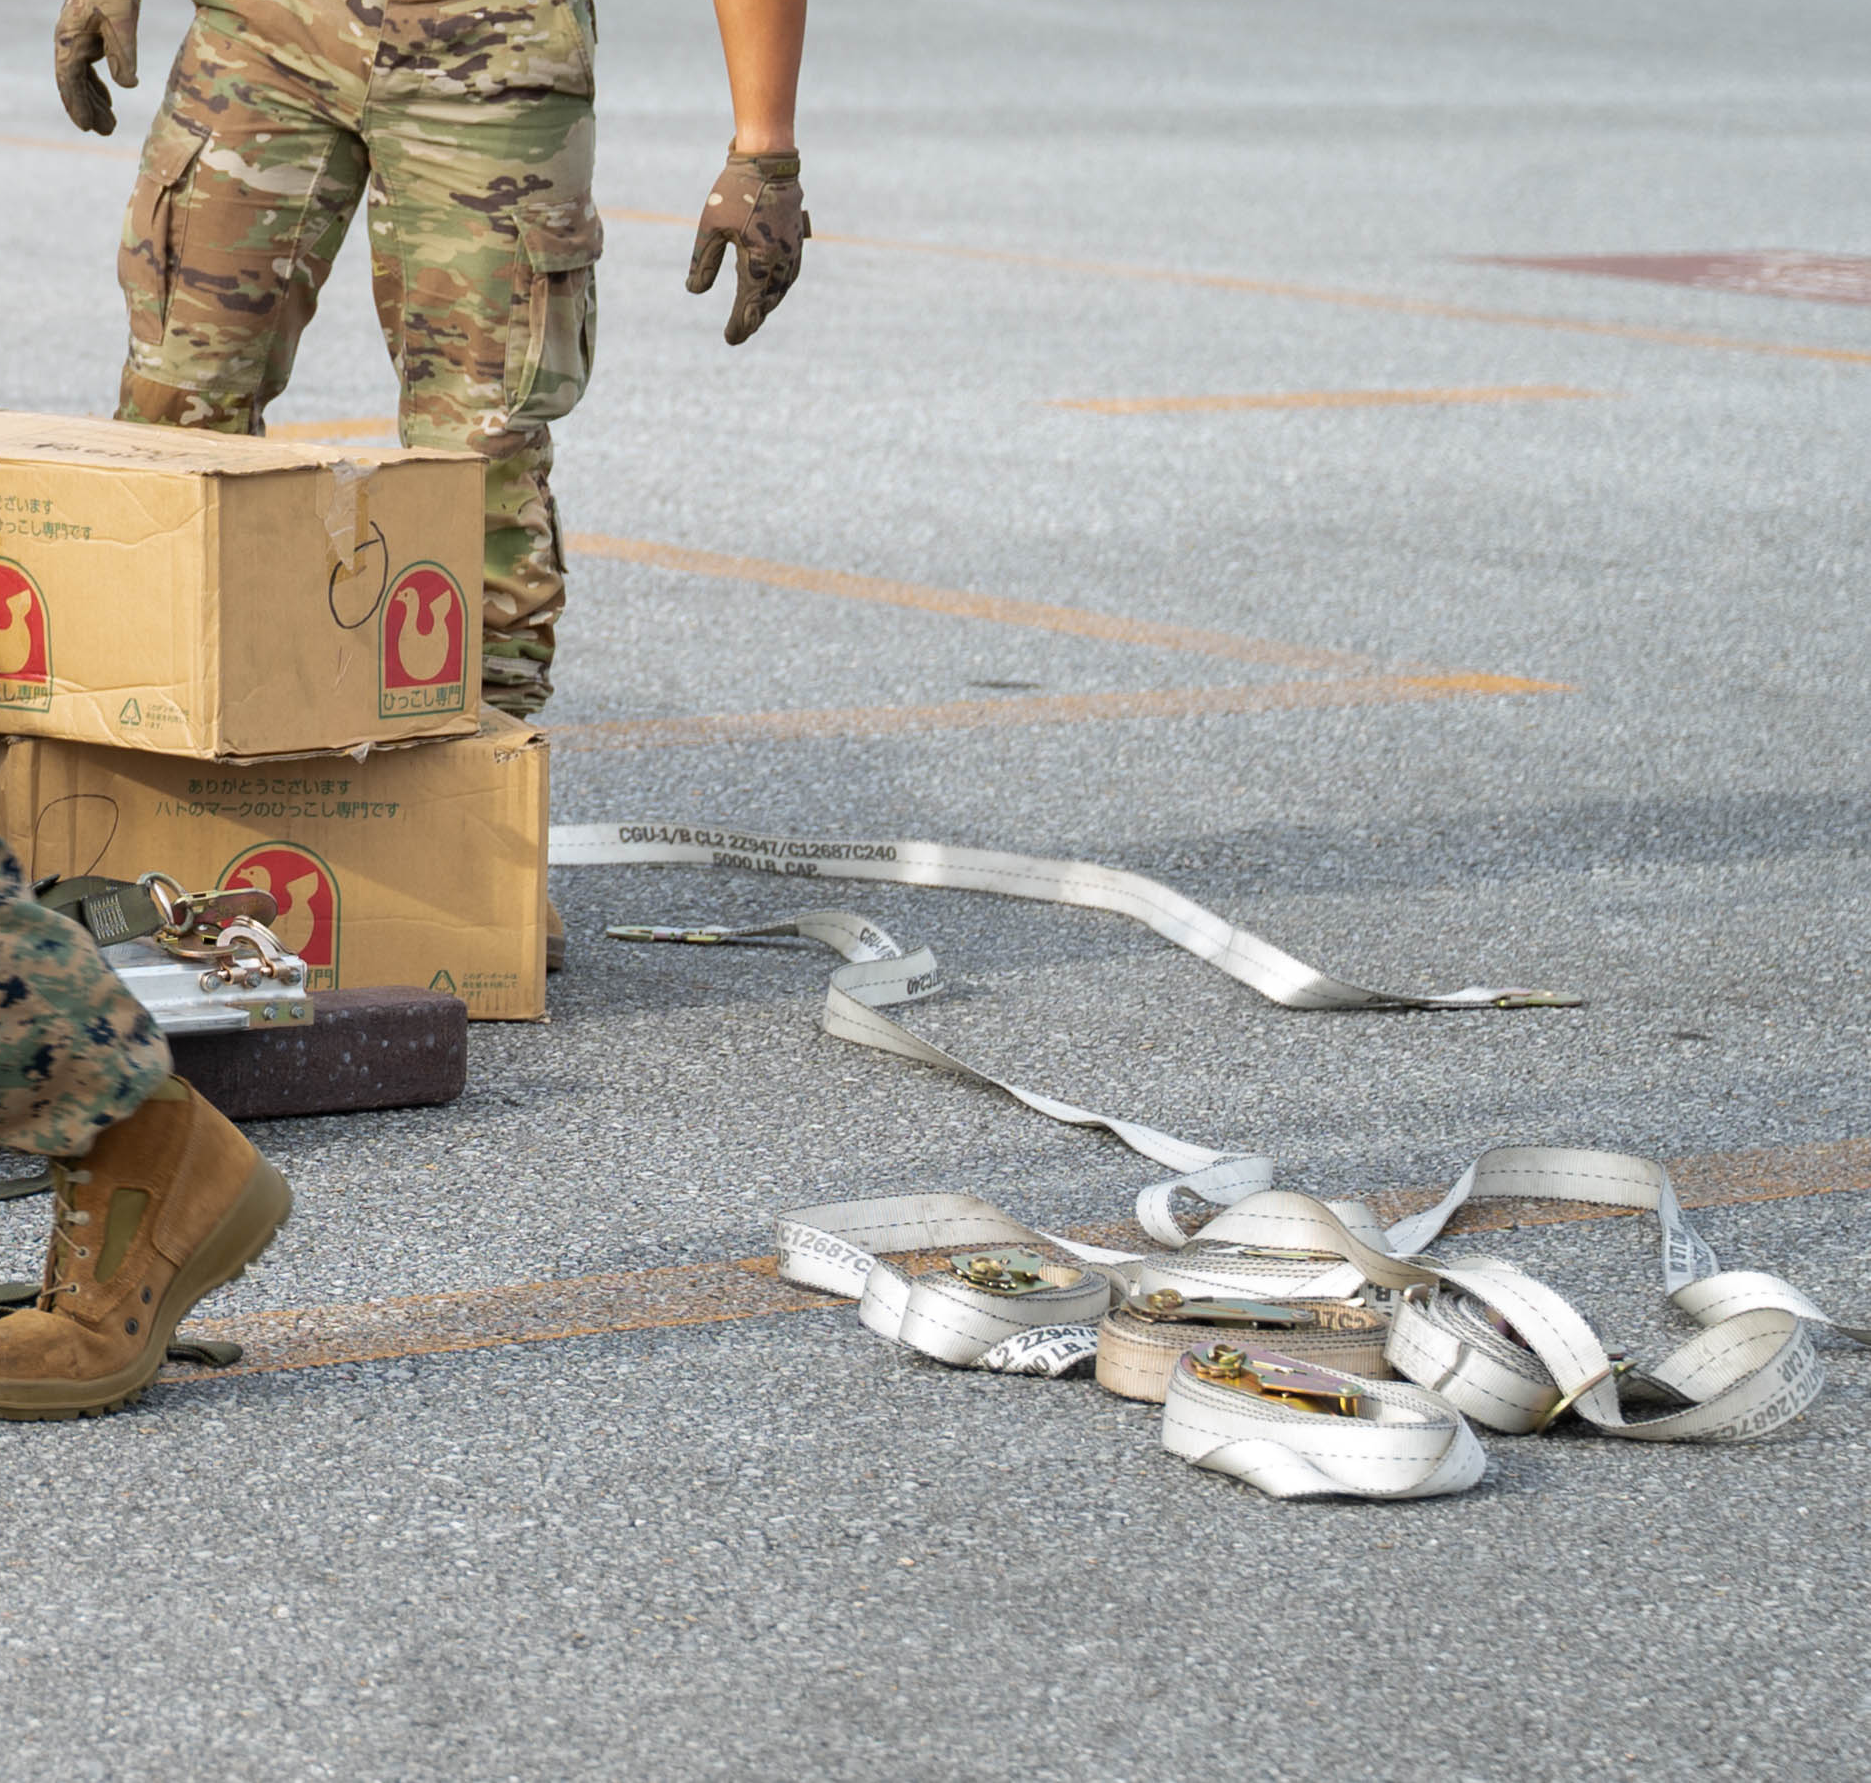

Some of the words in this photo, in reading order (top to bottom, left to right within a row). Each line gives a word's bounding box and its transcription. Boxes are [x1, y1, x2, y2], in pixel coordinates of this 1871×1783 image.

[383, 685, 461, 711] ひっこし専門
[187, 778, 352, 795] ありがとうございます
[156, 800, 400, 819] ハトのマークのひっこし専門です
[619, 826, 691, 845] CGU-1/B
[694, 830, 724, 848] CL2
[712, 852, 751, 870] 5000
